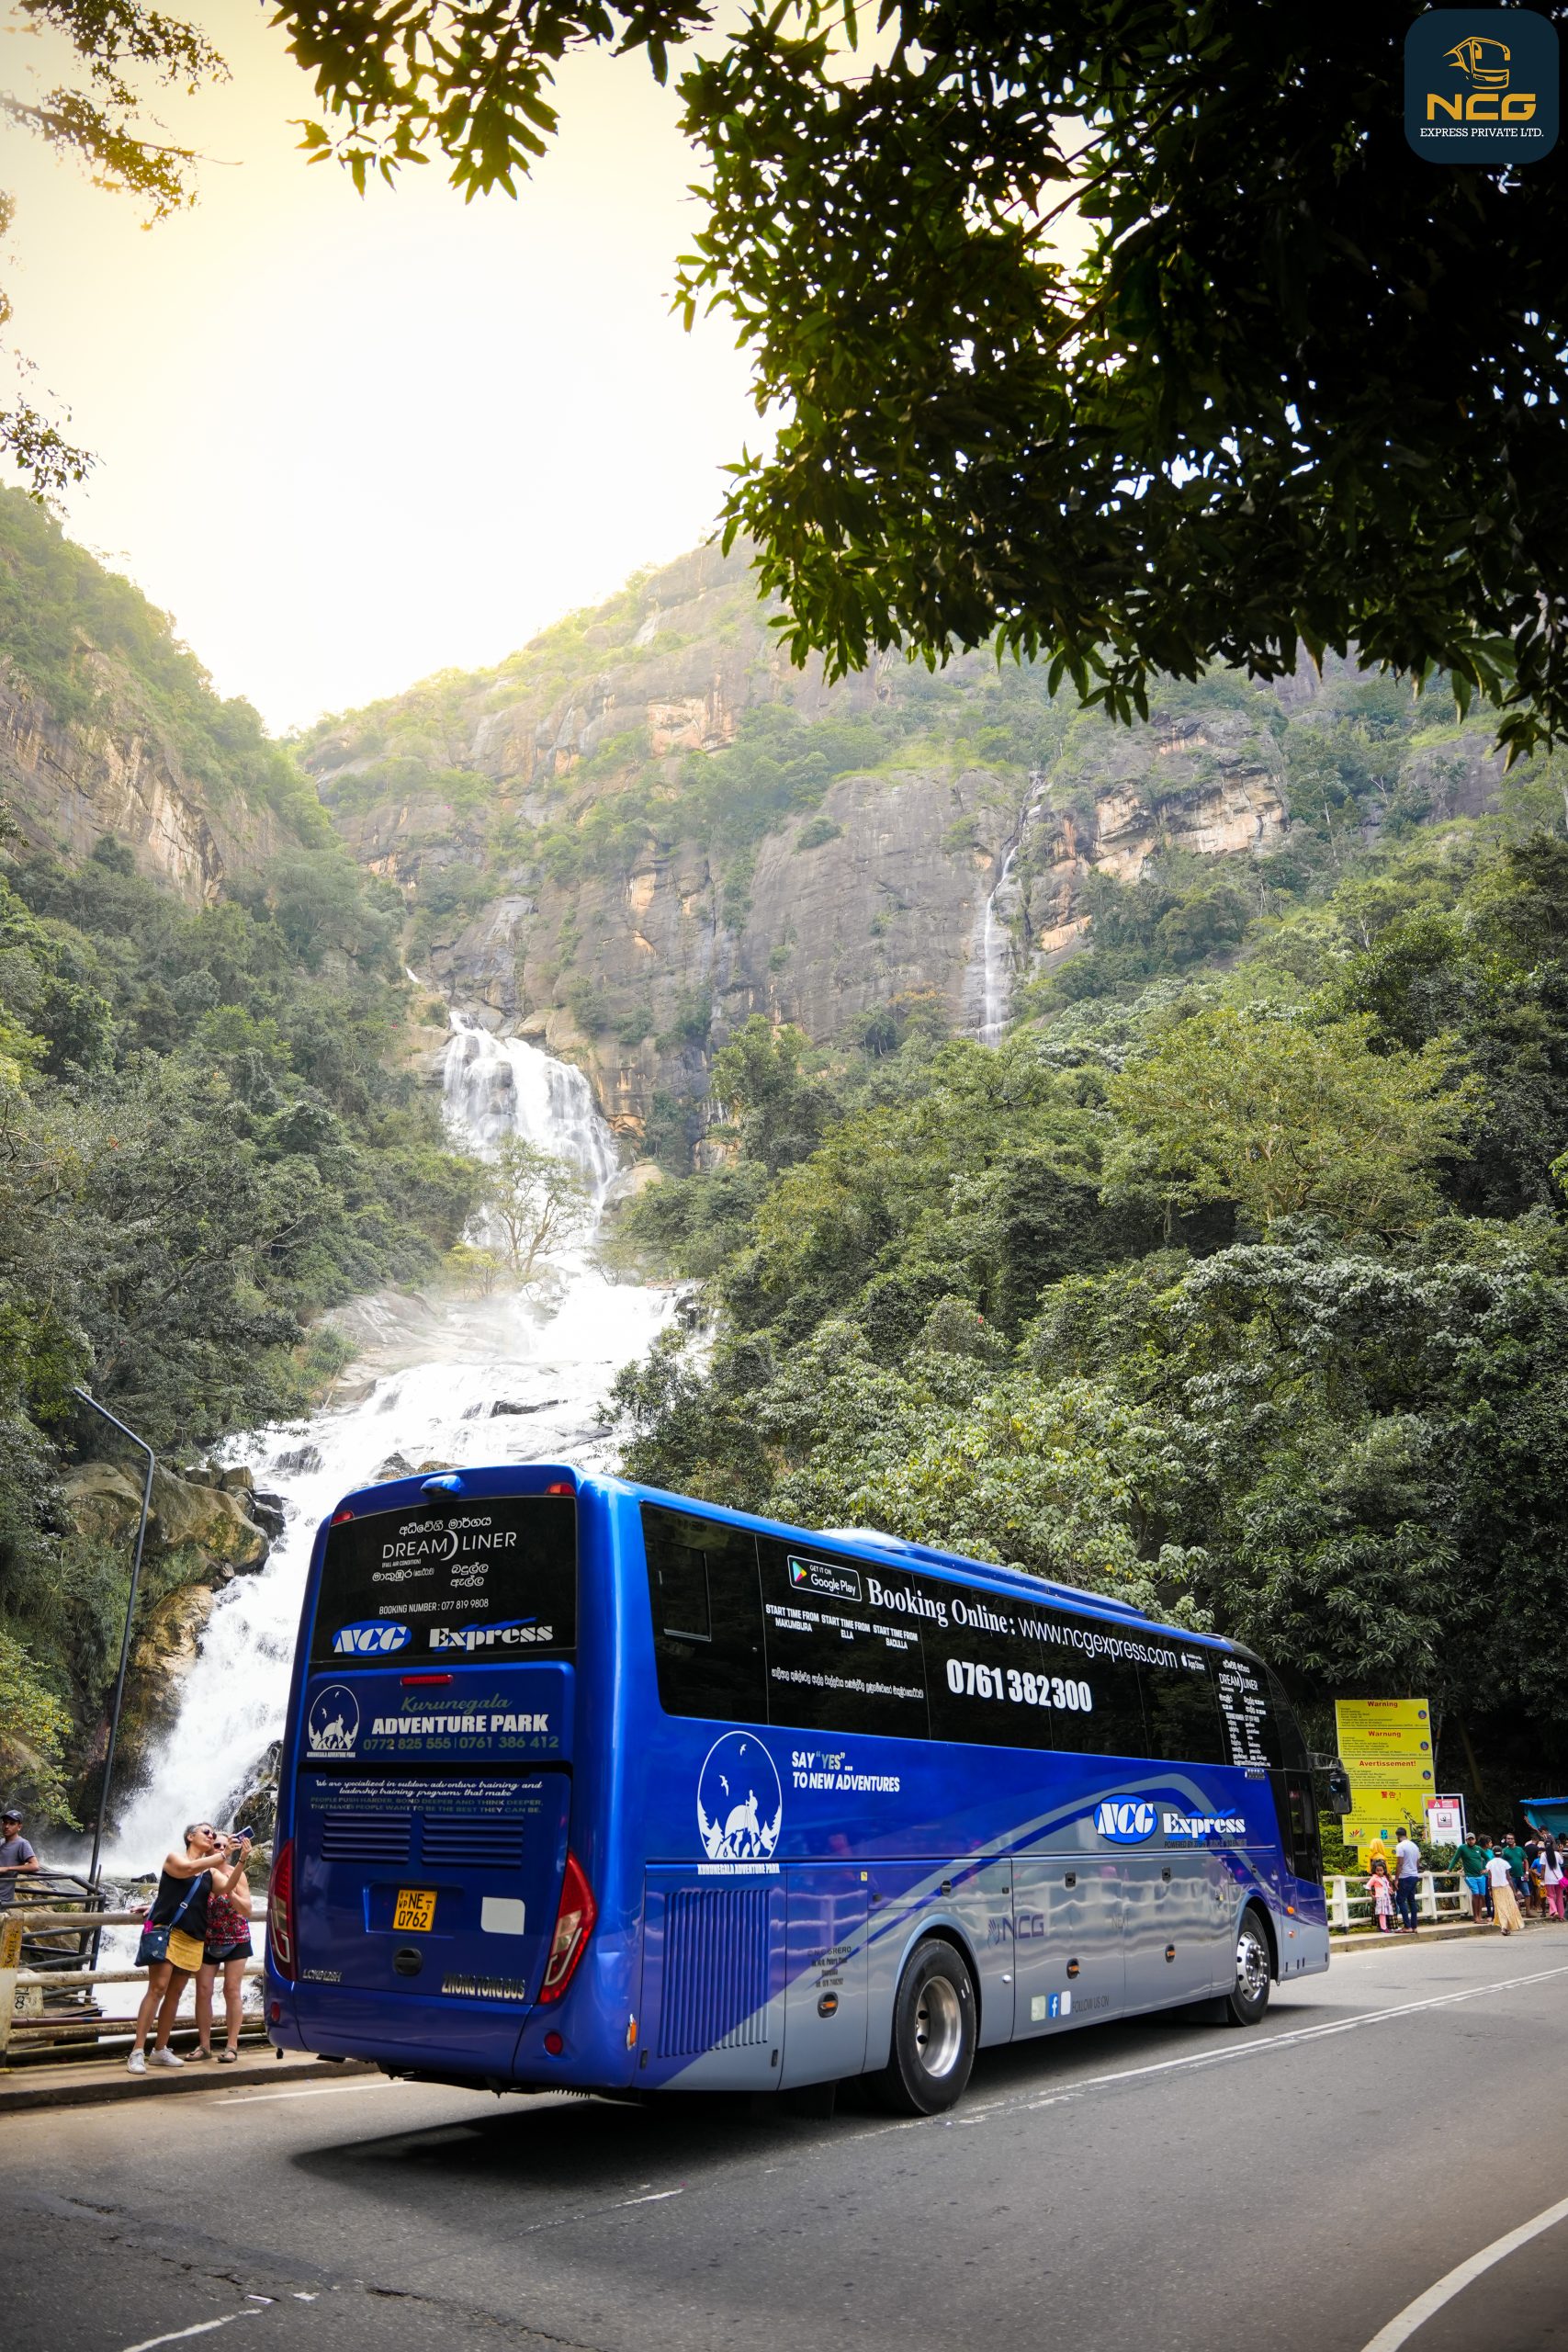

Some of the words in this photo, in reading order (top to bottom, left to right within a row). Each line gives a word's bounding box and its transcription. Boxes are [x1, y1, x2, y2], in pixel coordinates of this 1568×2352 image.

[382, 1538, 447, 1559] DREAM
[462, 1532, 517, 1551] LINER
[810, 1573, 840, 1593] Google
[840, 1581, 856, 1597] Play
[379, 1605, 407, 1614] BOOKING
[441, 1600, 455, 1611] 077
[456, 1600, 468, 1609] 819
[470, 1599, 489, 1608] 9808
[766, 1604, 786, 1617] START
[786, 1608, 802, 1620] TIME
[802, 1611, 819, 1623] FROM
[821, 1614, 840, 1627] START
[840, 1618, 854, 1630] TIME
[854, 1621, 871, 1633] FROM
[865, 1577, 948, 1627] Booking
[1017, 1617, 1179, 1668] www.ncgexpress.com
[333, 1626, 408, 1653] NCG
[429, 1625, 553, 1651] Express
[840, 1629, 854, 1640] ELLA
[873, 1624, 890, 1635] START
[890, 1628, 903, 1638] TIME
[903, 1631, 919, 1641] FROM
[946, 1658, 1004, 1700] 0761
[401, 1693, 512, 1714] Kurunegala
[372, 1715, 487, 1735] ADVENTURE
[491, 1714, 549, 1732] PARK
[364, 1738, 395, 1750] 0772
[398, 1738, 423, 1749] 825
[426, 1737, 451, 1749] 555
[459, 1736, 492, 1749] 0761
[499, 1736, 525, 1748] 386
[530, 1736, 558, 1748] 412
[792, 1751, 815, 1769] SAY
[479, 1781, 519, 1791] training
[522, 1781, 542, 1789] and
[793, 1772, 807, 1788] TO
[809, 1773, 834, 1790] NEW
[835, 1774, 900, 1792] ADVENTURES
[379, 1788, 415, 1797] training
[416, 1790, 461, 1798] programs
[1097, 1803, 1154, 1835] NCG
[1162, 1813, 1246, 1838] Express
[399, 1911, 428, 1928] 0762
[1002, 1914, 1044, 1940] NCG
